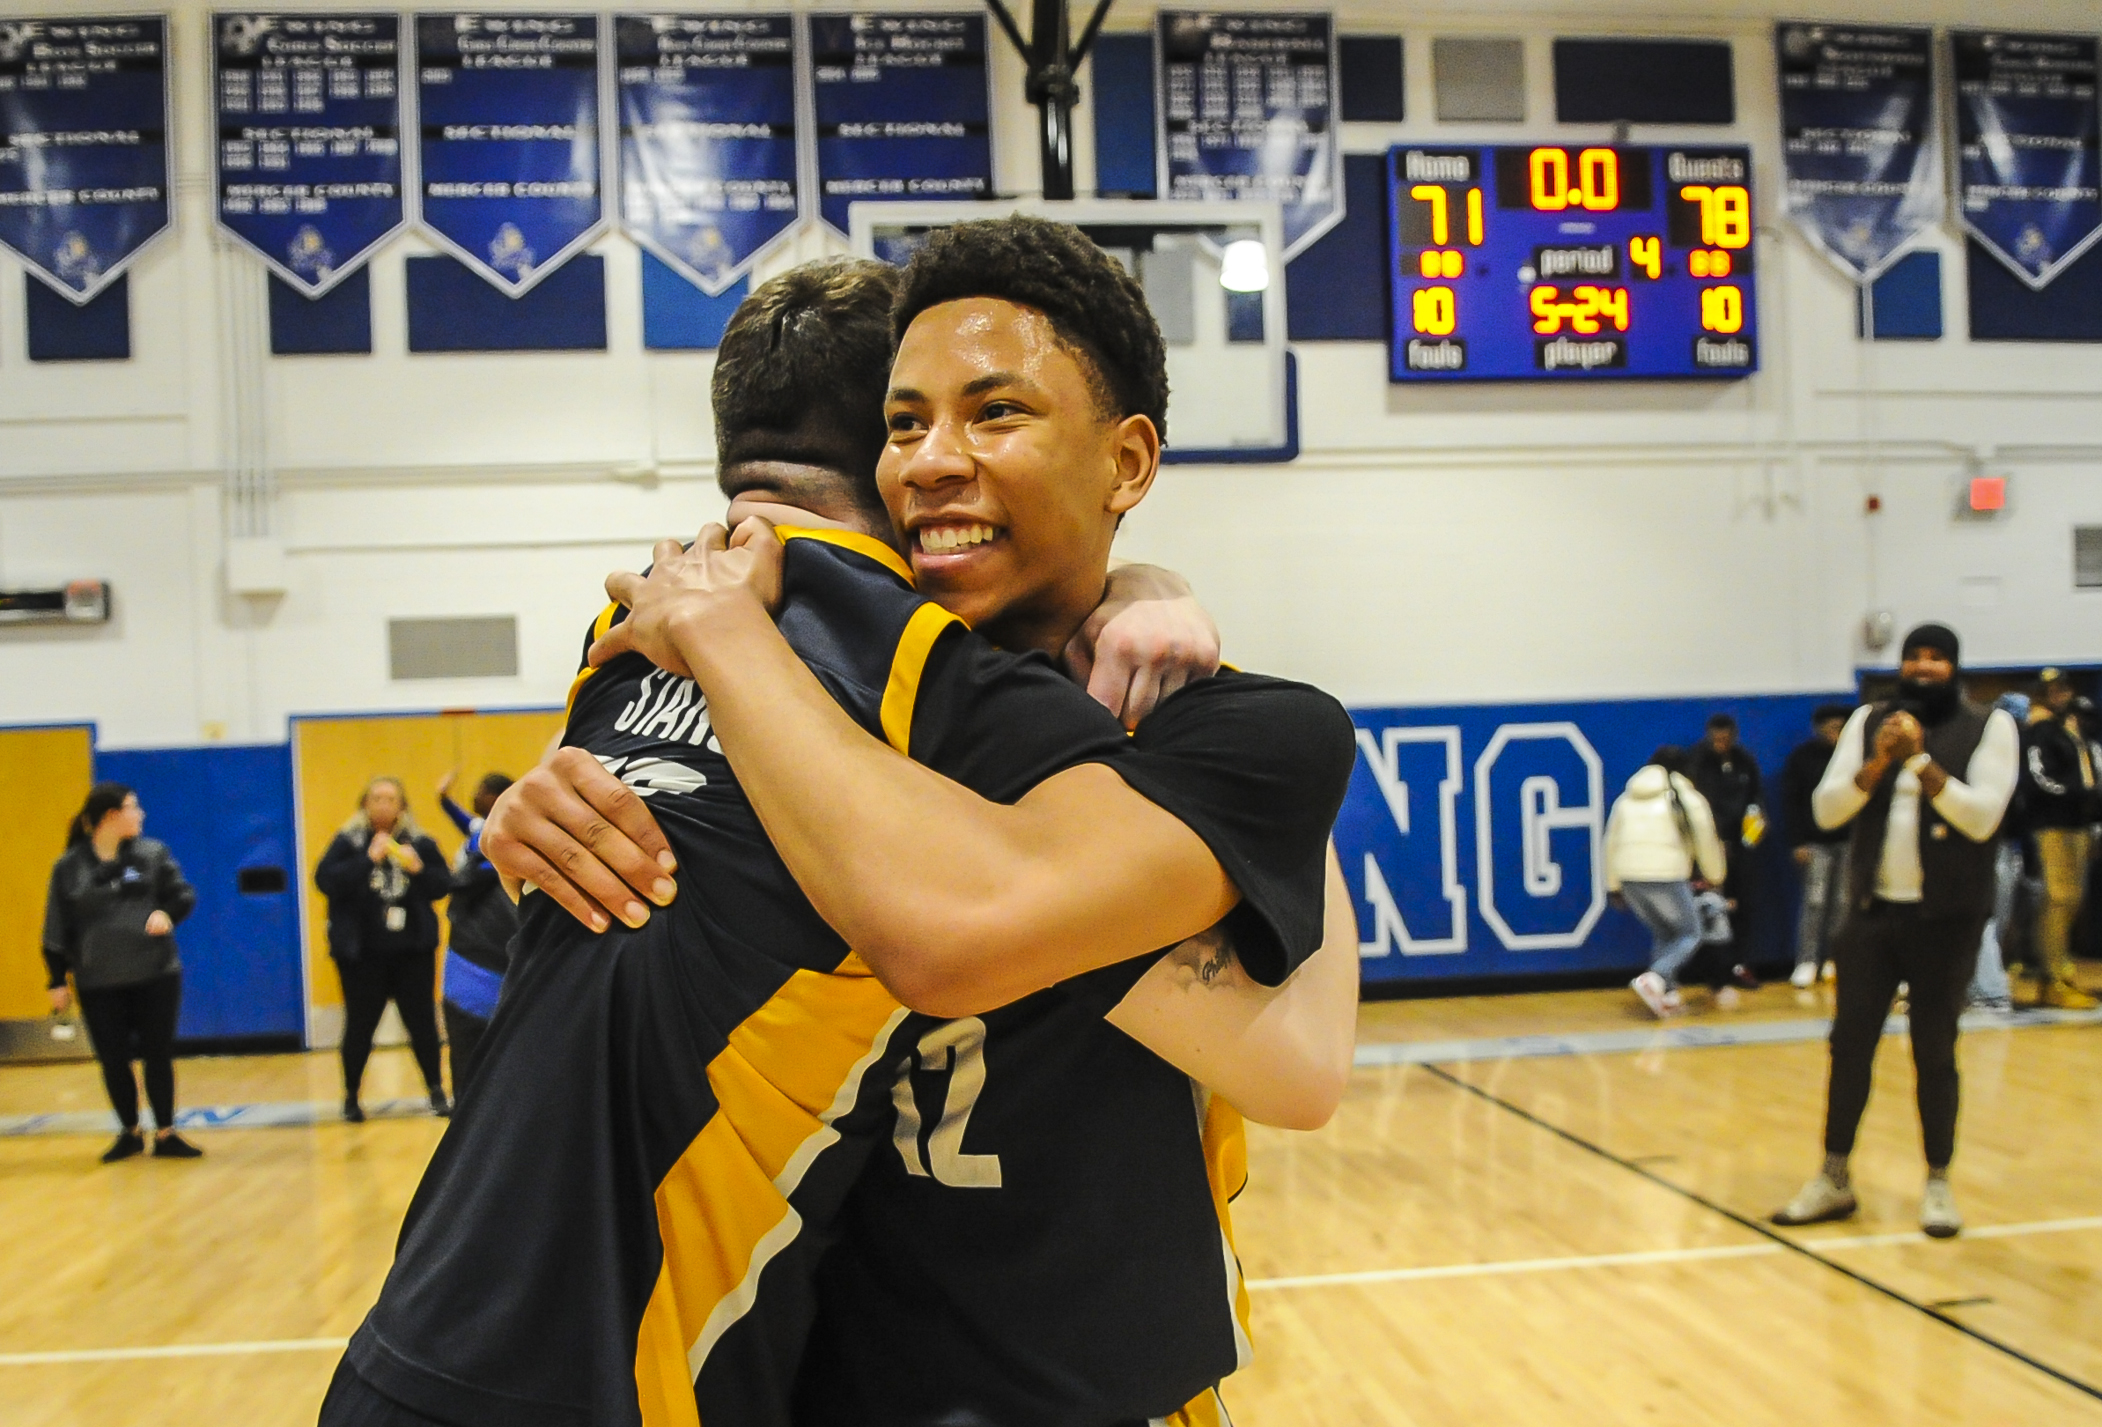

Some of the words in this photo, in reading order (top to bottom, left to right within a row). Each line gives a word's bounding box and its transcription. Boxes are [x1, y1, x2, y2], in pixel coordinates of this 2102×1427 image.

[1529, 147, 1619, 211] 0.0
[1411, 185, 1483, 246] 71
[1681, 186, 1750, 249] 78
[1540, 245, 1614, 278] period
[1629, 236, 1661, 280] 4
[1412, 286, 1455, 336] 10
[1701, 285, 1742, 334] 10
[1544, 336, 1617, 371] player
